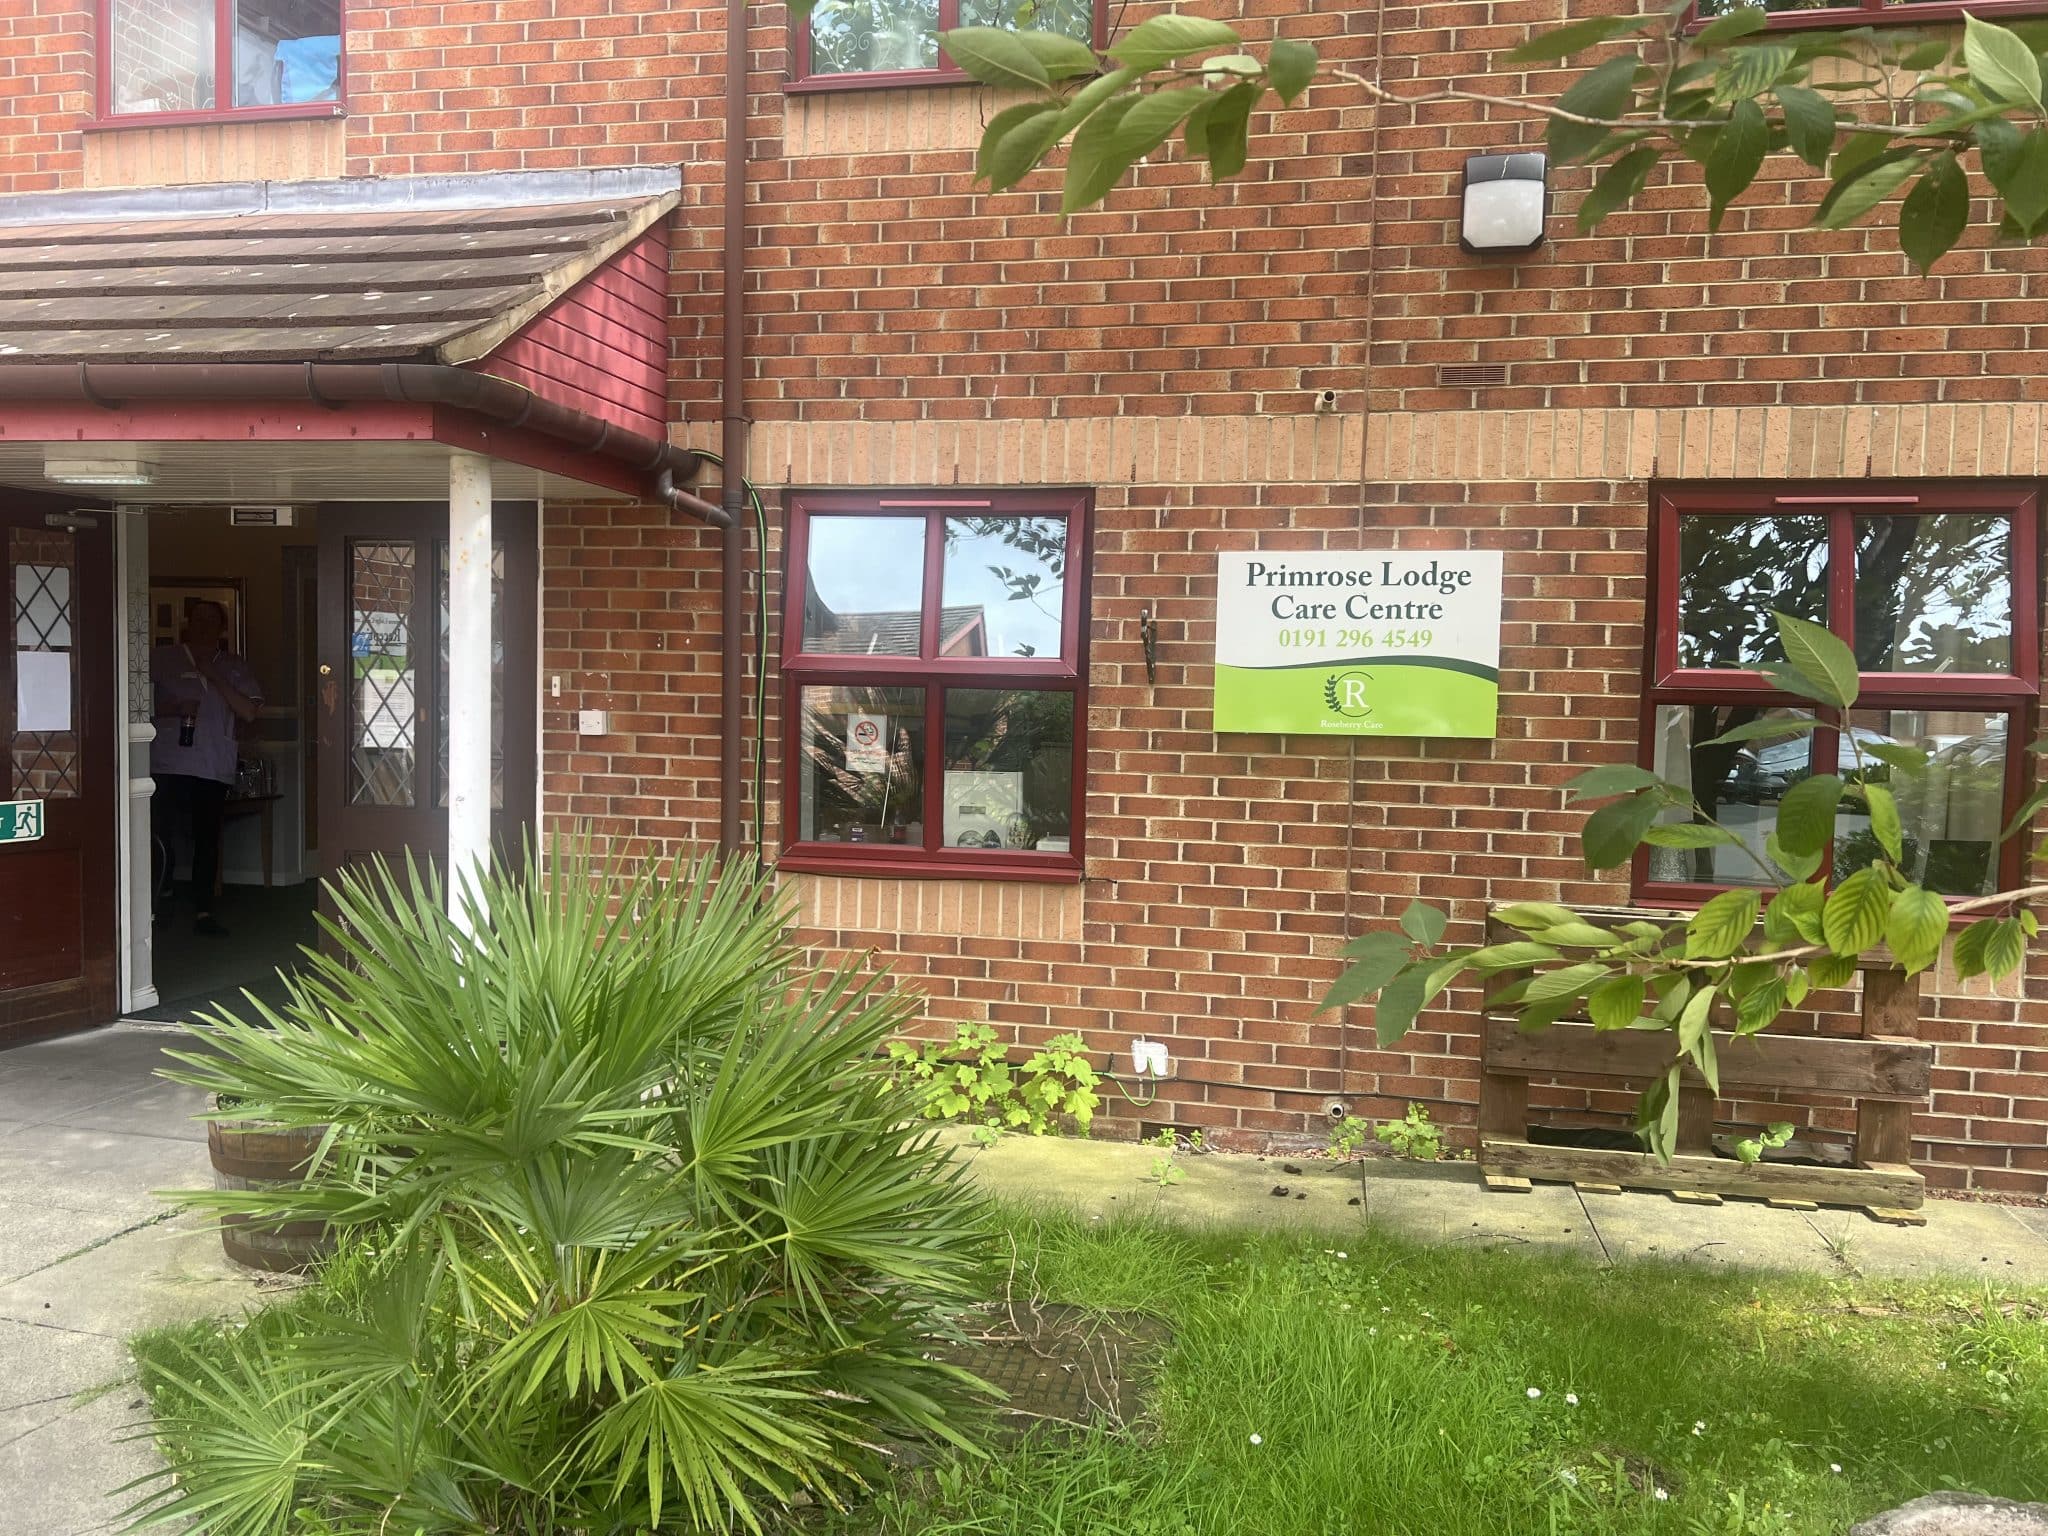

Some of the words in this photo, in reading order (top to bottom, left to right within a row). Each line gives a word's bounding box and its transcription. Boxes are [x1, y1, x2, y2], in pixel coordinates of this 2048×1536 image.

[1246, 561, 1373, 587] Primrose
[1380, 560, 1472, 595] Lodge
[1271, 594, 1337, 620] Care
[1345, 594, 1443, 620] Centre
[1278, 629, 1326, 648] 0191
[1335, 629, 1374, 648] 296
[1381, 629, 1433, 648] 4549
[1342, 679, 1370, 709] R
[1320, 719, 1362, 730] Roseberry
[1363, 720, 1384, 730] Care
